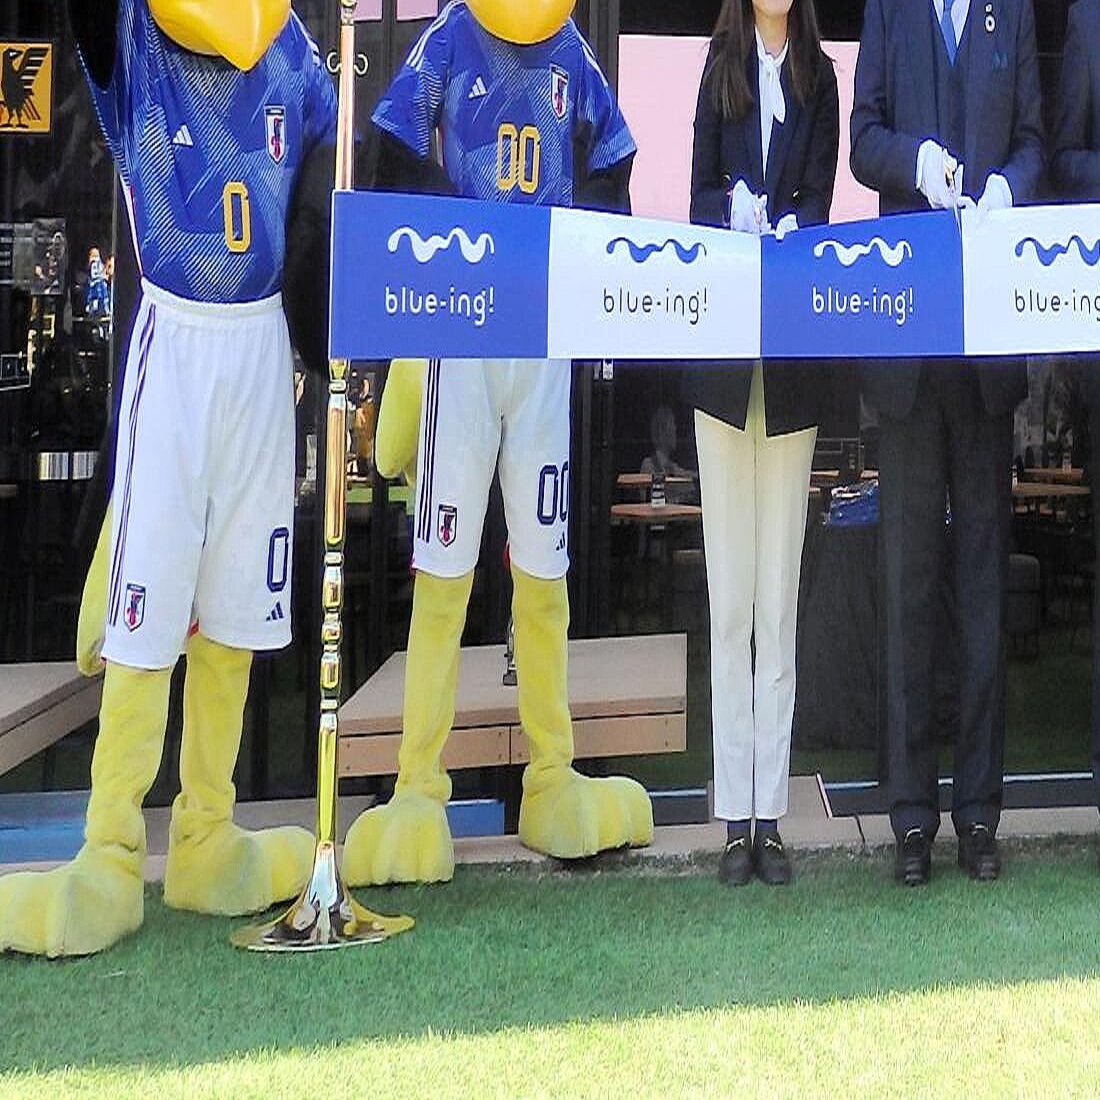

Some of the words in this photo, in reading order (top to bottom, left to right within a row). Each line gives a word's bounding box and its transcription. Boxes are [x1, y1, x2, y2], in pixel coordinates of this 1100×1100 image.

[496, 123, 541, 194] 00
[223, 181, 251, 253] 0
[385, 286, 496, 326] blue-ing!
[603, 287, 708, 326] blue-ing!
[811, 286, 914, 326] blue-ing!
[267, 527, 289, 593] 0
